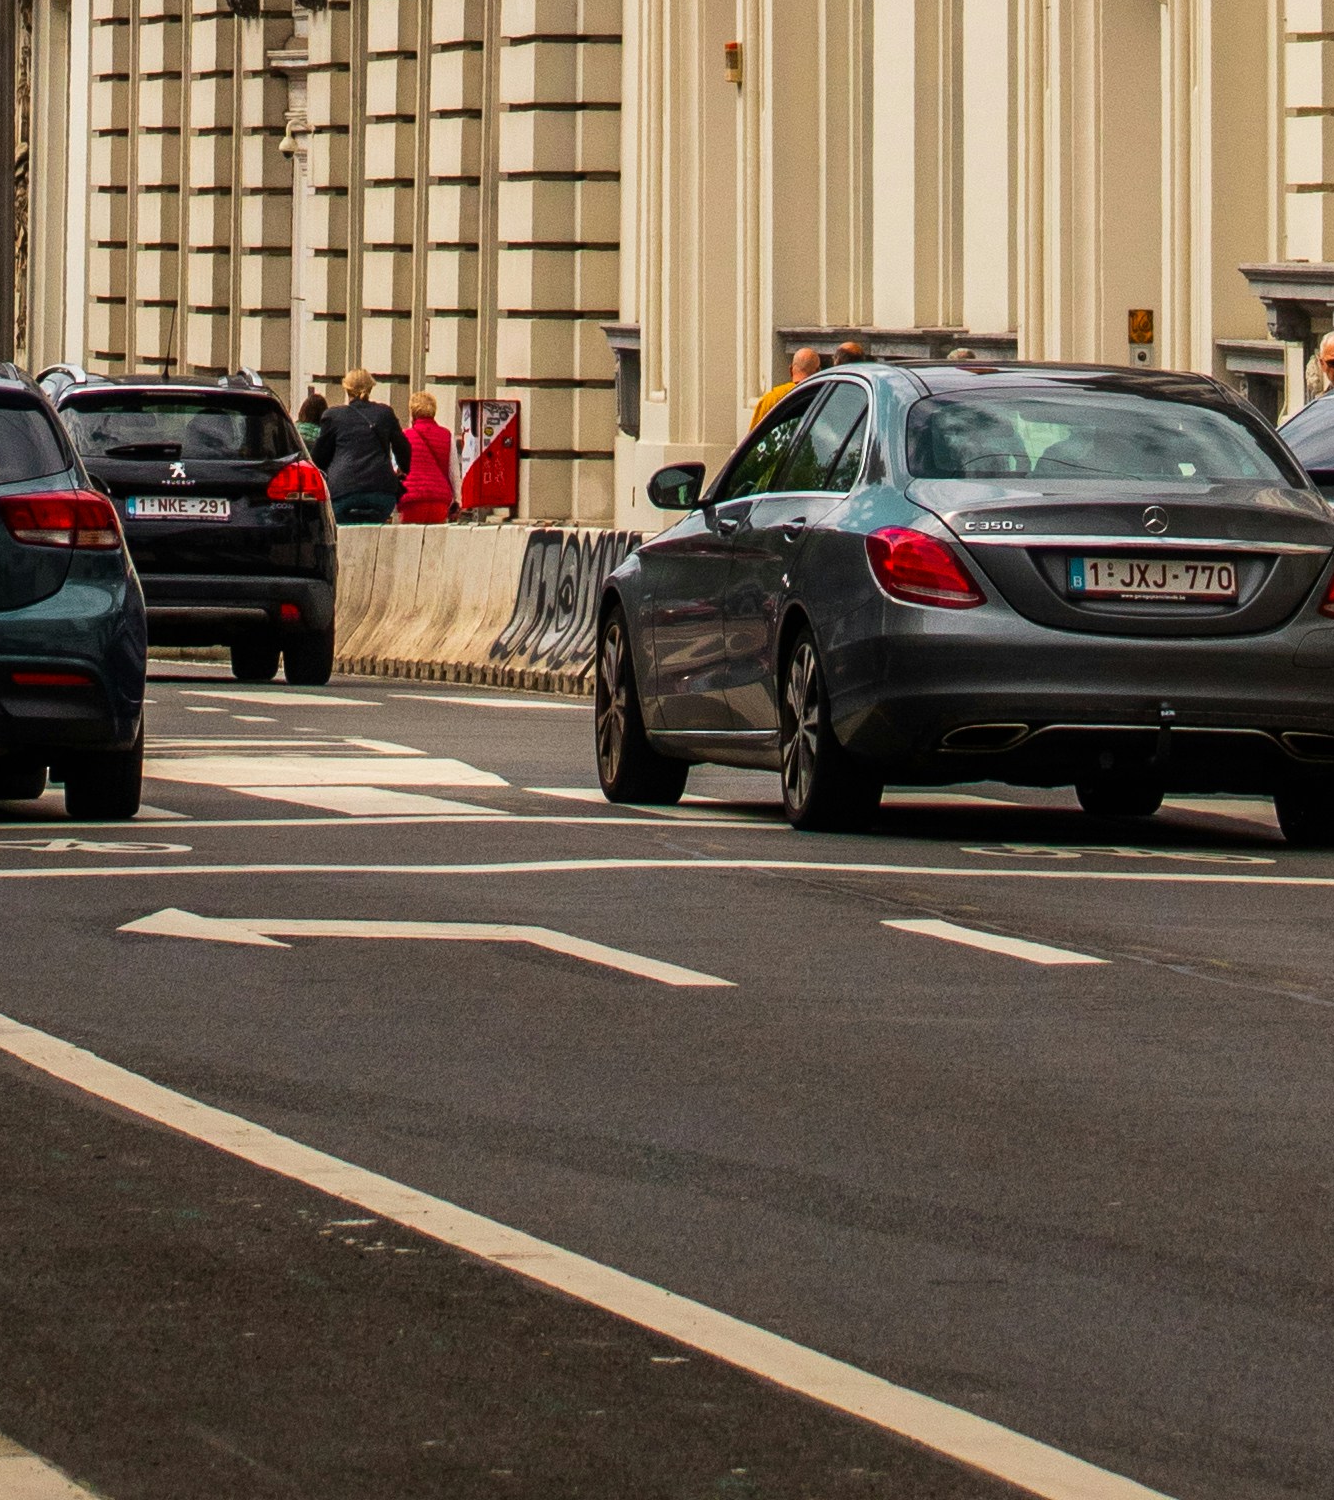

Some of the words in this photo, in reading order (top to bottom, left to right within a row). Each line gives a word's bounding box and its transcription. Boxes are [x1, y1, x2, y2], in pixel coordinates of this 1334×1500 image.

[139, 499, 227, 514] 1-NKE-291
[1072, 575, 1083, 588] B
[1089, 562, 1233, 590] 1-JXJ-770
